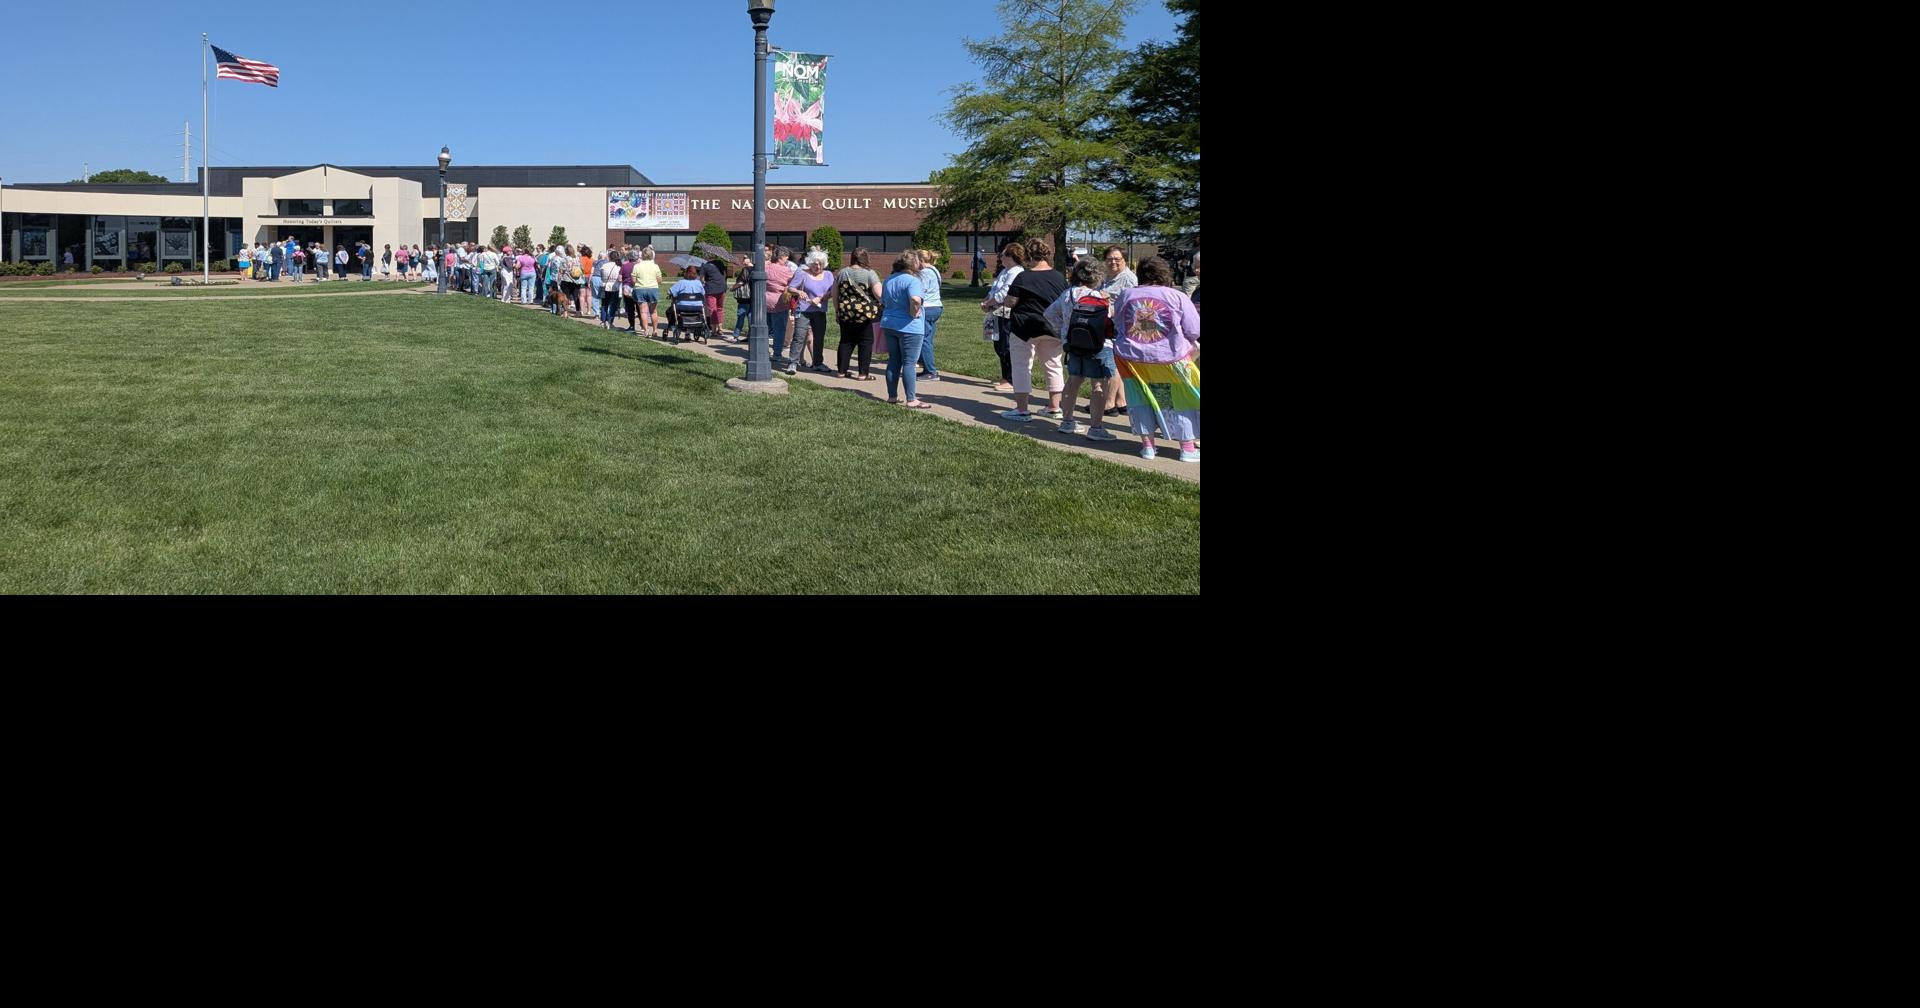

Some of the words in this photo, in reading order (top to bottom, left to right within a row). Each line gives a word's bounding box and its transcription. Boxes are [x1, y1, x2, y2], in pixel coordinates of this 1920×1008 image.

[782, 62, 819, 80] NQM
[690, 199, 721, 210] THE
[731, 198, 812, 210] NAONAL
[822, 198, 872, 210] QUILT
